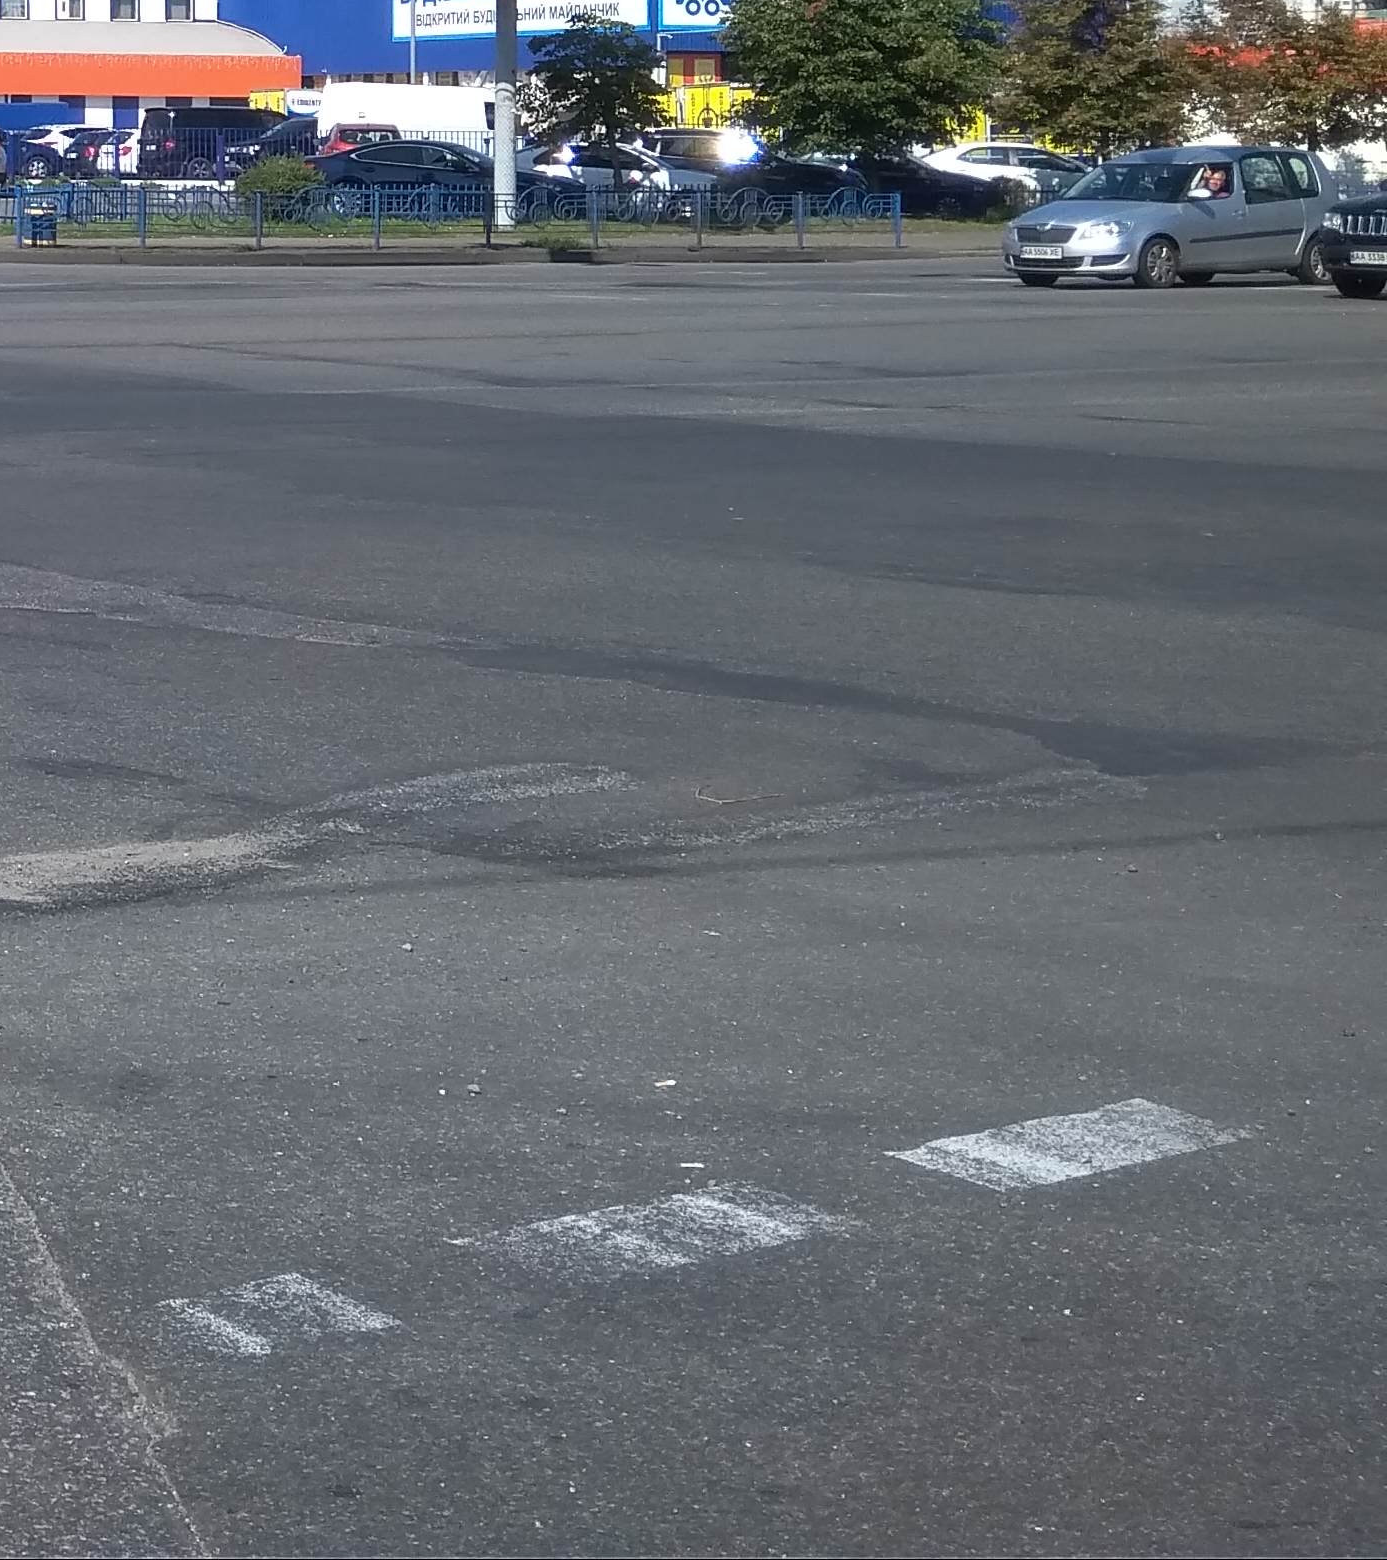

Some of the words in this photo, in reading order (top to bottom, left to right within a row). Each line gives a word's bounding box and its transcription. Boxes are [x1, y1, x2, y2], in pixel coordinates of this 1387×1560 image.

[415, 8, 470, 28] ВІДКРИТИЙ
[473, 3, 546, 26] БУДІЬНИЙ
[548, 1, 621, 21] МАЙДАНЧИК
